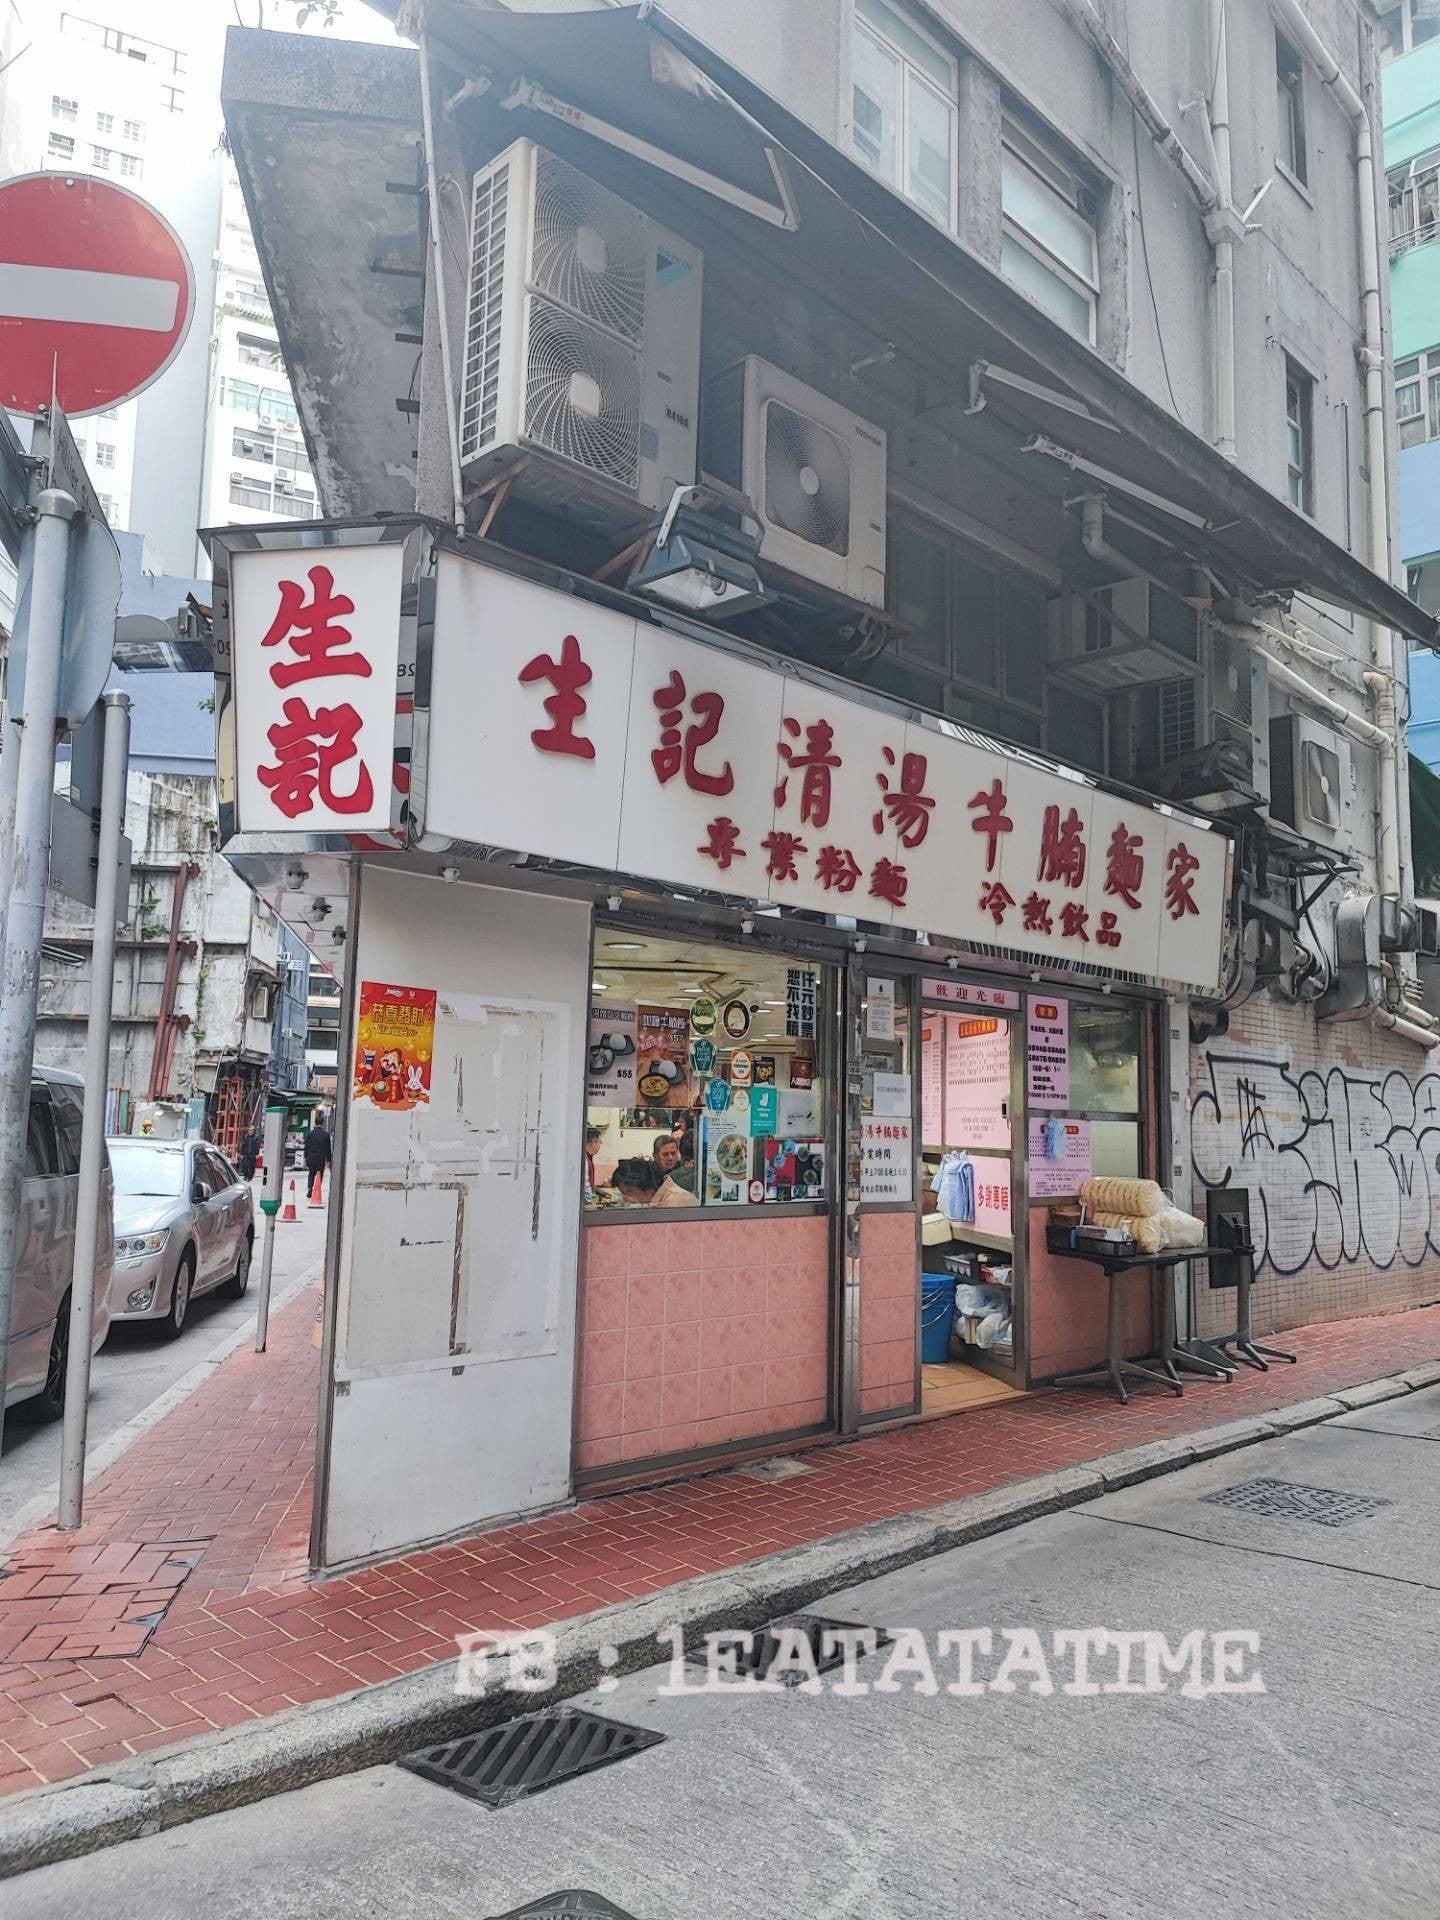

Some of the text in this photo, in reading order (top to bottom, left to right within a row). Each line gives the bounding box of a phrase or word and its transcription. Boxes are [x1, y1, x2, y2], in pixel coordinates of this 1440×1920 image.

[666, 407, 689, 428] R410A
[257, 565, 374, 819] 生記
[517, 634, 1201, 921] 生記清湯牛腩麵家
[697, 816, 1123, 948] 專業粉麵 冷熱飲品
[371, 1002, 424, 1027] 恭喜發財
[936, 984, 1005, 1004] 歡迎光臨
